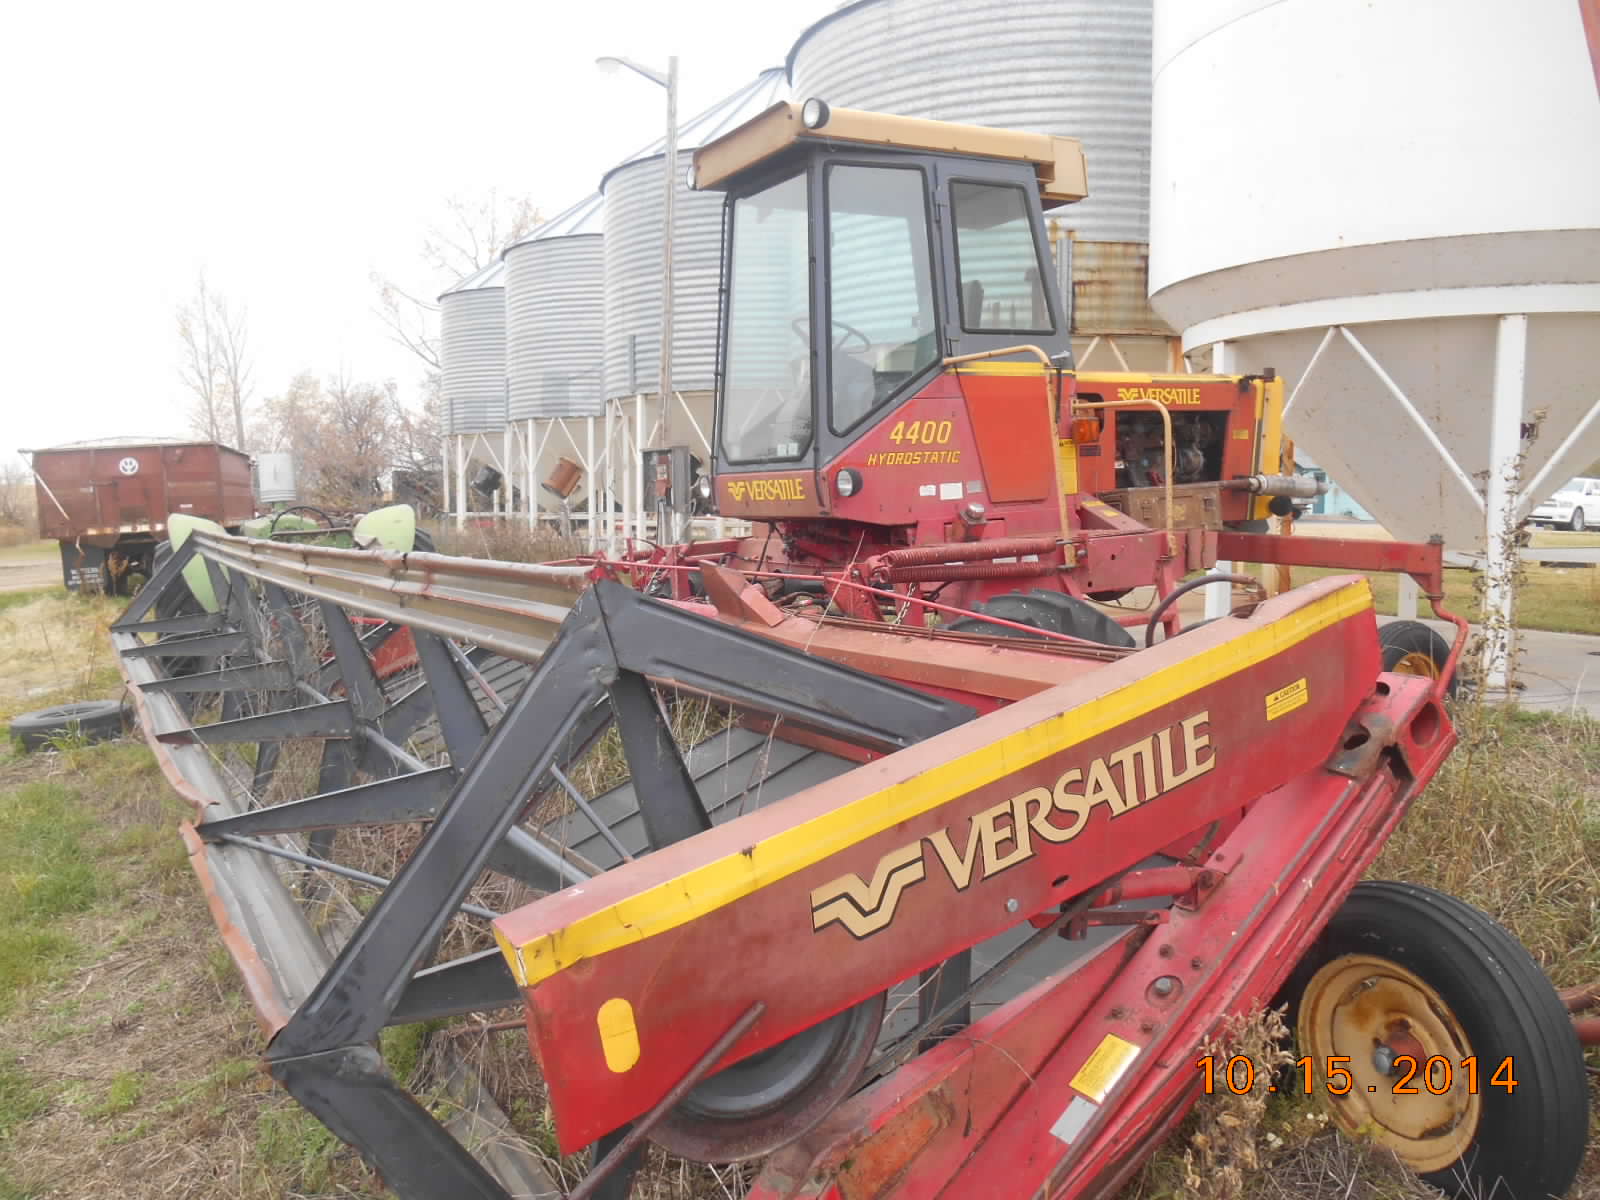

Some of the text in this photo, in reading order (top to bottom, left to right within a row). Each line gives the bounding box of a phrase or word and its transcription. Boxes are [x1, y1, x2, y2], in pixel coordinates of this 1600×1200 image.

[1139, 387, 1201, 405] VERSATILE
[889, 420, 952, 445] 4400
[867, 450, 961, 466] HYDROSTATIC
[745, 478, 806, 501] VERSATILE
[925, 711, 1216, 891] VERSATILE
